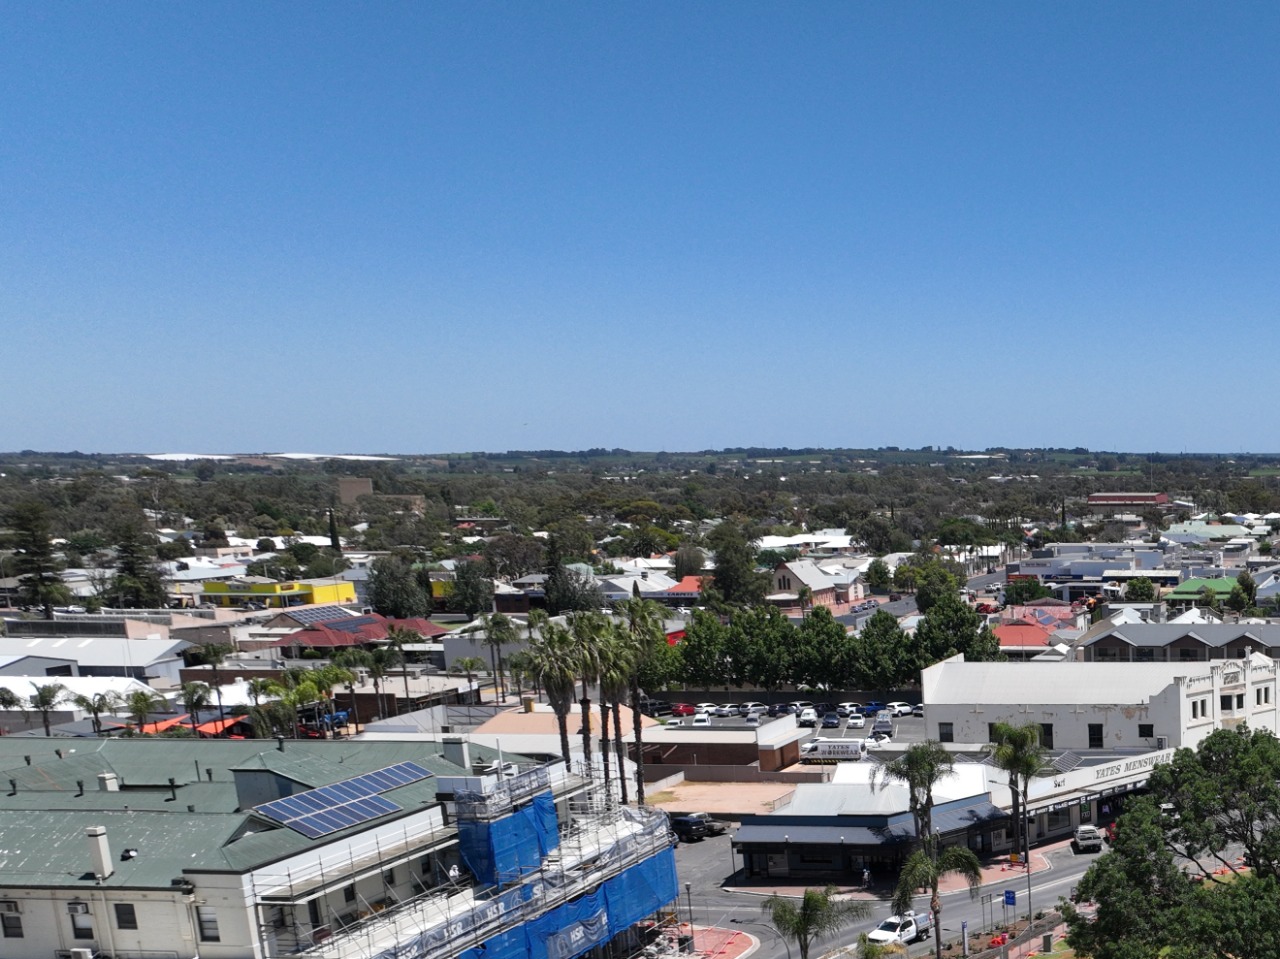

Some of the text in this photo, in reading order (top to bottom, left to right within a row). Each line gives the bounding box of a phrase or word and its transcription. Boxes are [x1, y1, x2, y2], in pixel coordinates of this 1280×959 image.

[1095, 752, 1172, 780] YATES MENSWEAR
[1053, 778, 1066, 789] Surf
[486, 902, 506, 920] HSR
[443, 922, 463, 941] HSR
[570, 926, 585, 943] HSR
